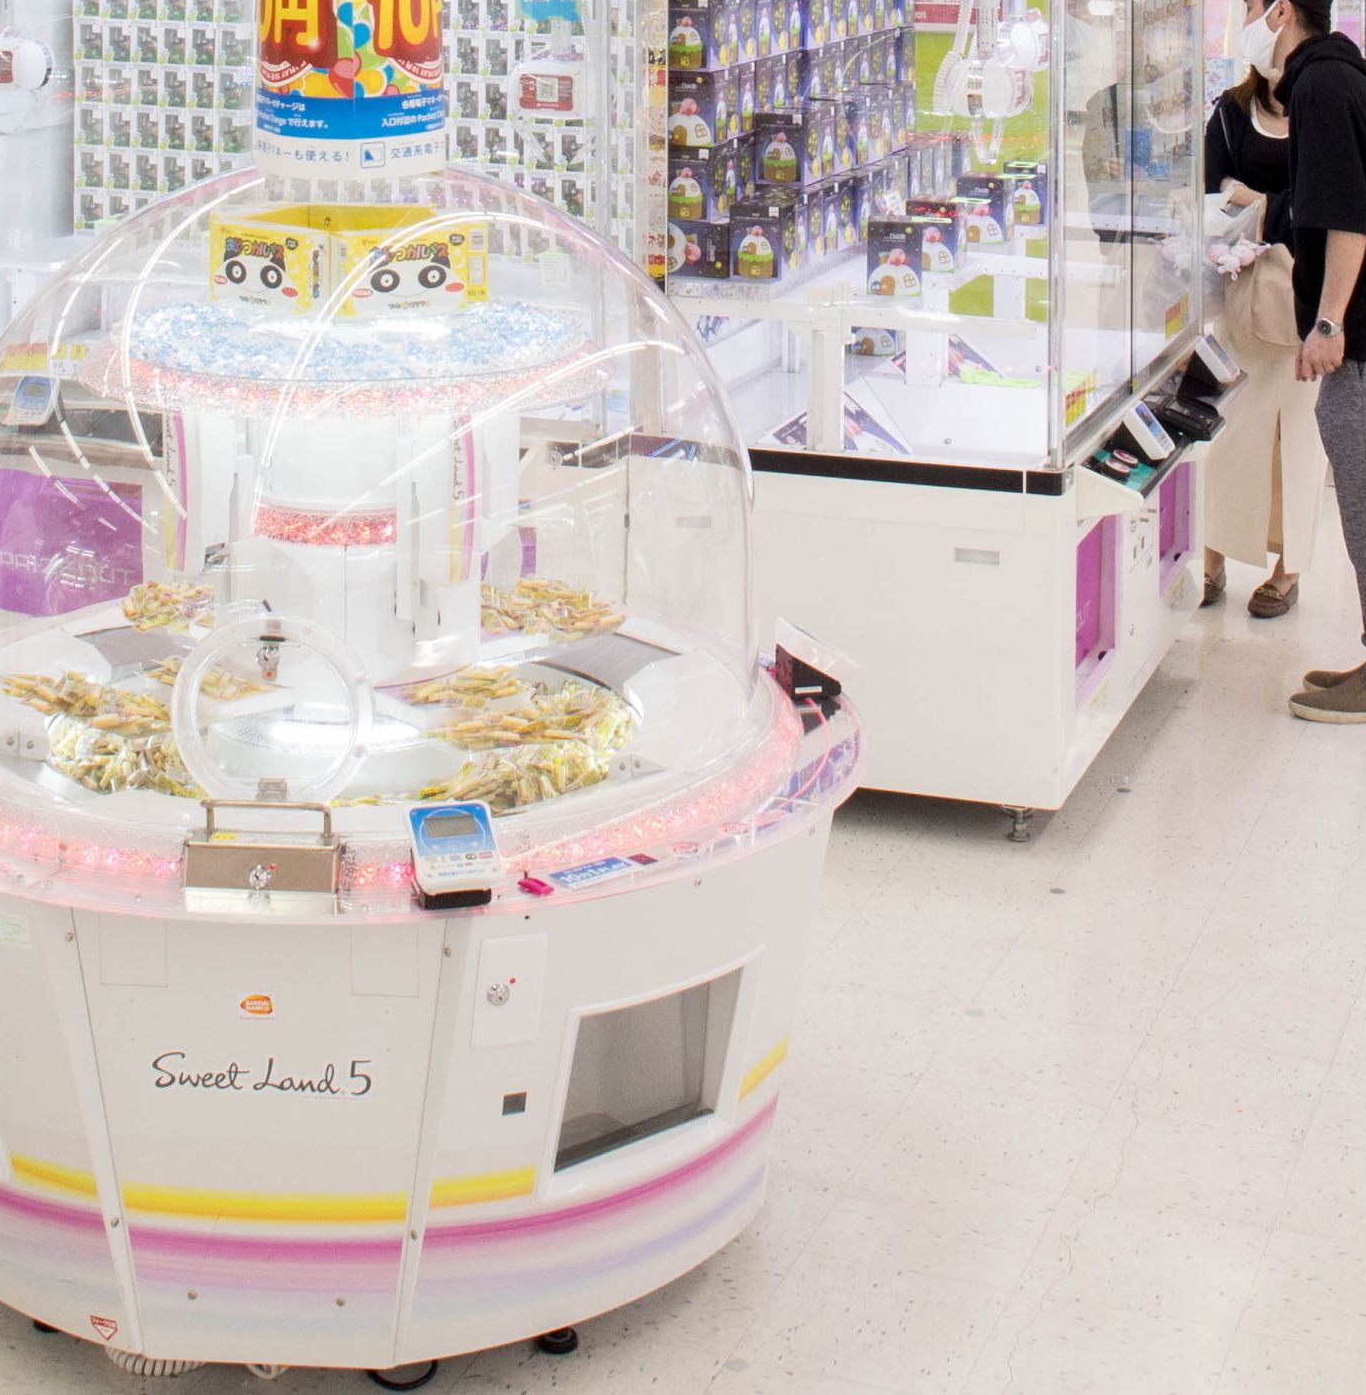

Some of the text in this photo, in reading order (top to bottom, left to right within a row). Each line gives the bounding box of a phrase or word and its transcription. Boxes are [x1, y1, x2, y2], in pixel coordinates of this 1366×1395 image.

[151, 1051, 373, 1096] Sweet Land 5
